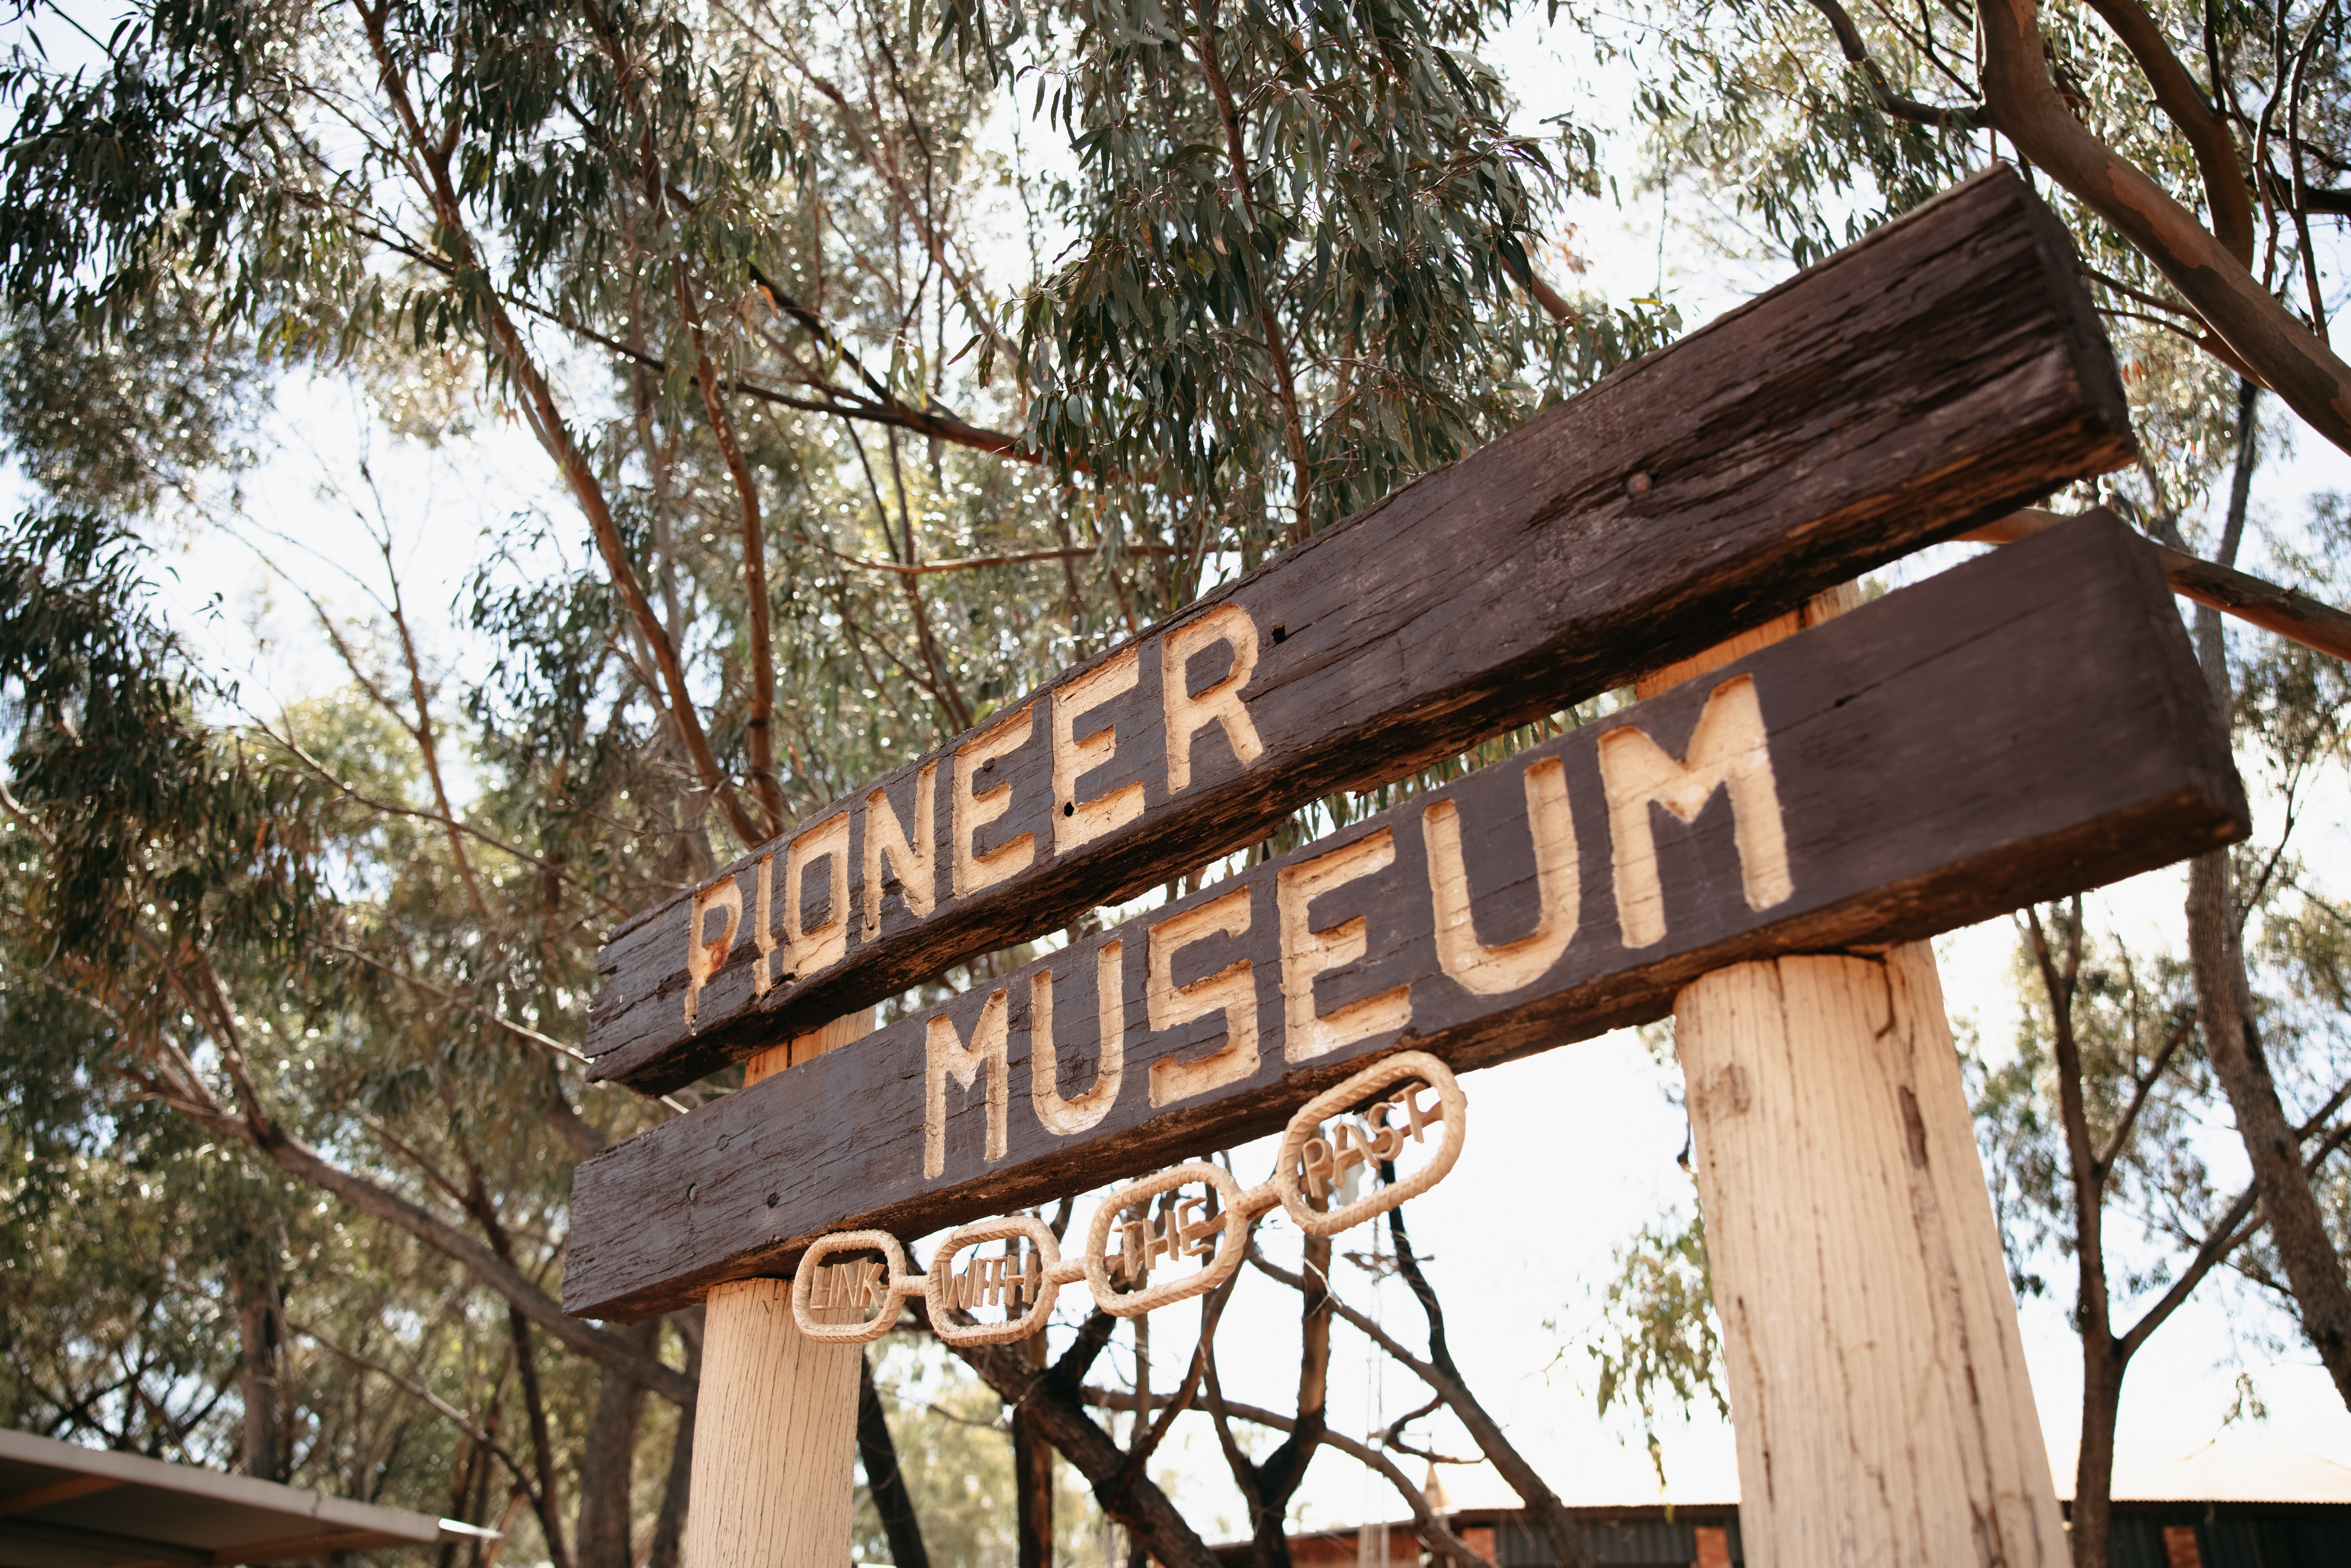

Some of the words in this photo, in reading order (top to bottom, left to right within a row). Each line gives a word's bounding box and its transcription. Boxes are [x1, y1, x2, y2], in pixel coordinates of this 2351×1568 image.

[685, 602, 1264, 1027] PIONEER
[924, 673, 1794, 1178] MUSEUM
[810, 1262, 886, 1310] LINK
[942, 1253, 1037, 1310] WITH
[1112, 1196, 1214, 1278] THE
[1302, 1081, 1427, 1199] PAST
